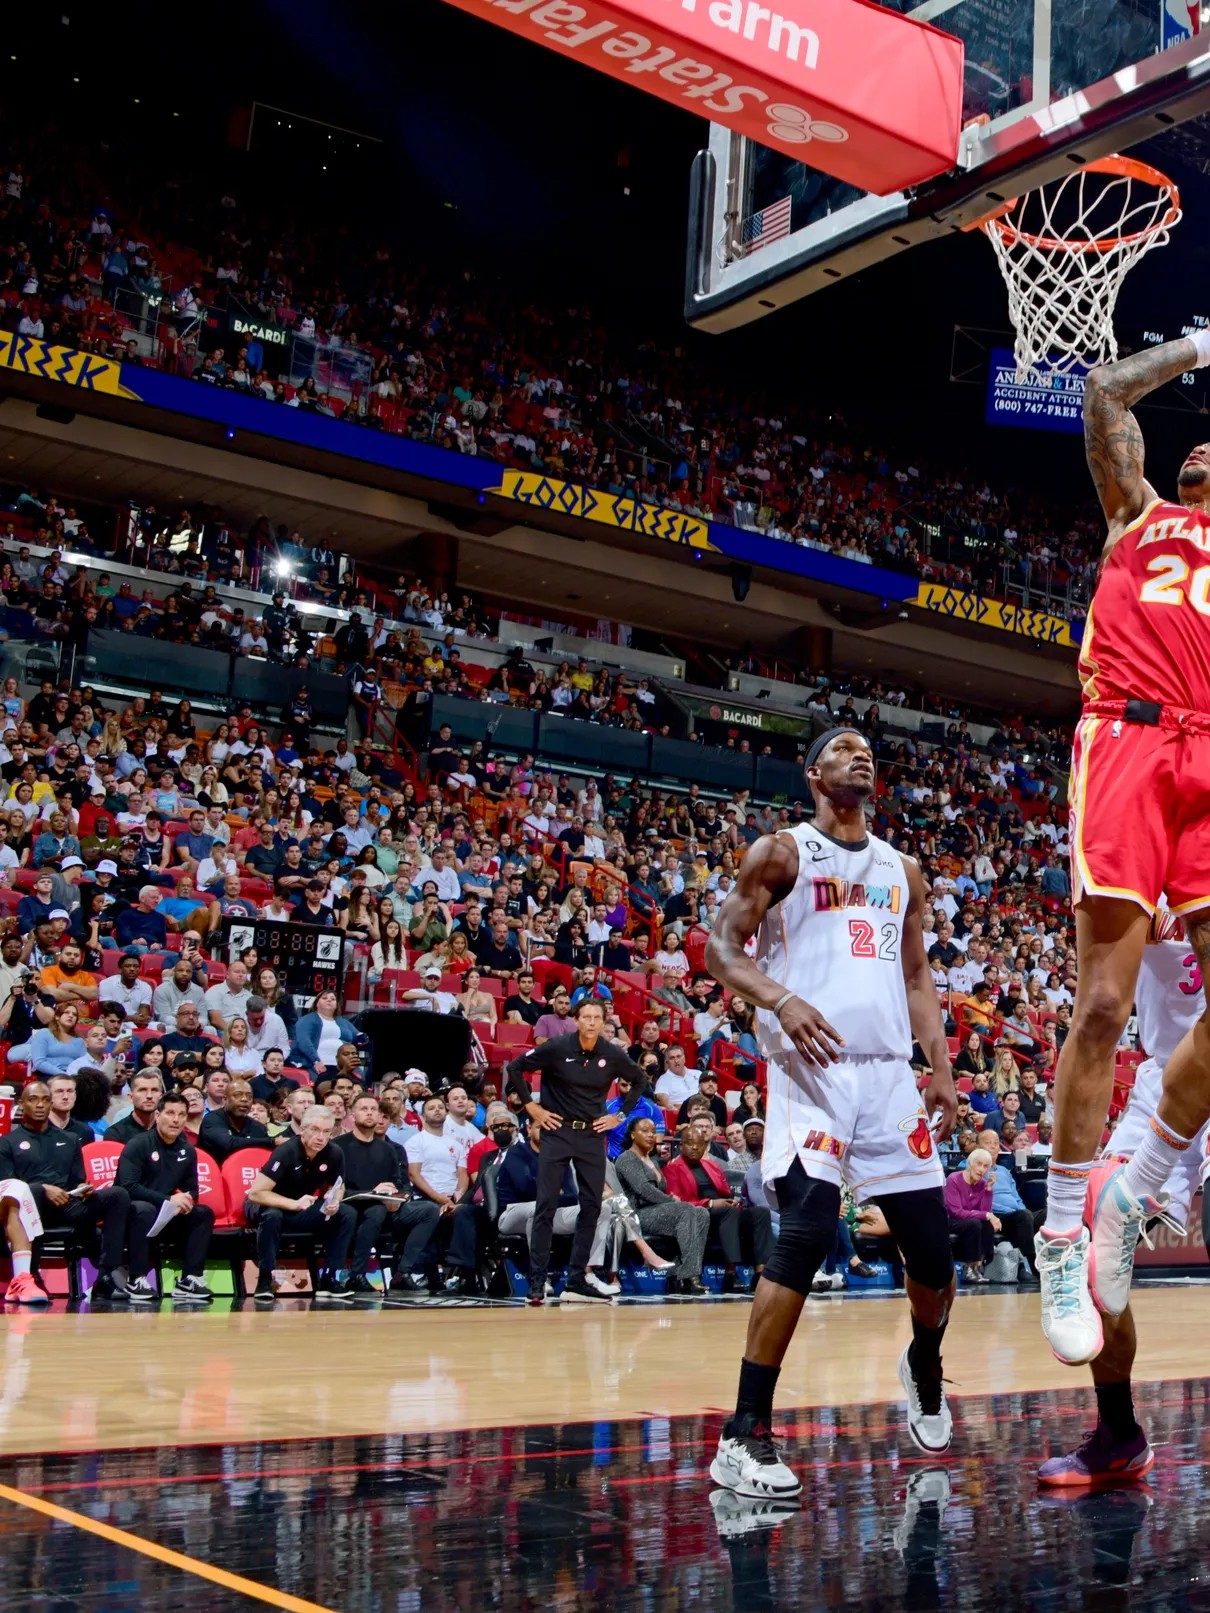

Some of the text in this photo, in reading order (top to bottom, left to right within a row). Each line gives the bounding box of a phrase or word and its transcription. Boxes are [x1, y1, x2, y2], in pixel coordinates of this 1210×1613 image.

[484, 0, 769, 113] StateFar
[1143, 331, 1164, 343] FGM
[0, 332, 109, 390] REEK
[1053, 377, 1063, 389] &
[1065, 379, 1086, 392] LEV
[1182, 372, 1195, 385] 53
[994, 387, 1082, 406] ACCIDENT ATTOR
[994, 398, 1078, 418] (800) 747-FREE
[612, 495, 701, 546] GREEK
[998, 602, 1066, 643] GREEK
[723, 709, 762, 728] BACARDÍ
[848, 919, 898, 961] 22
[312, 960, 336, 970] HAWKS
[93, 1172, 117, 1181] STEE
